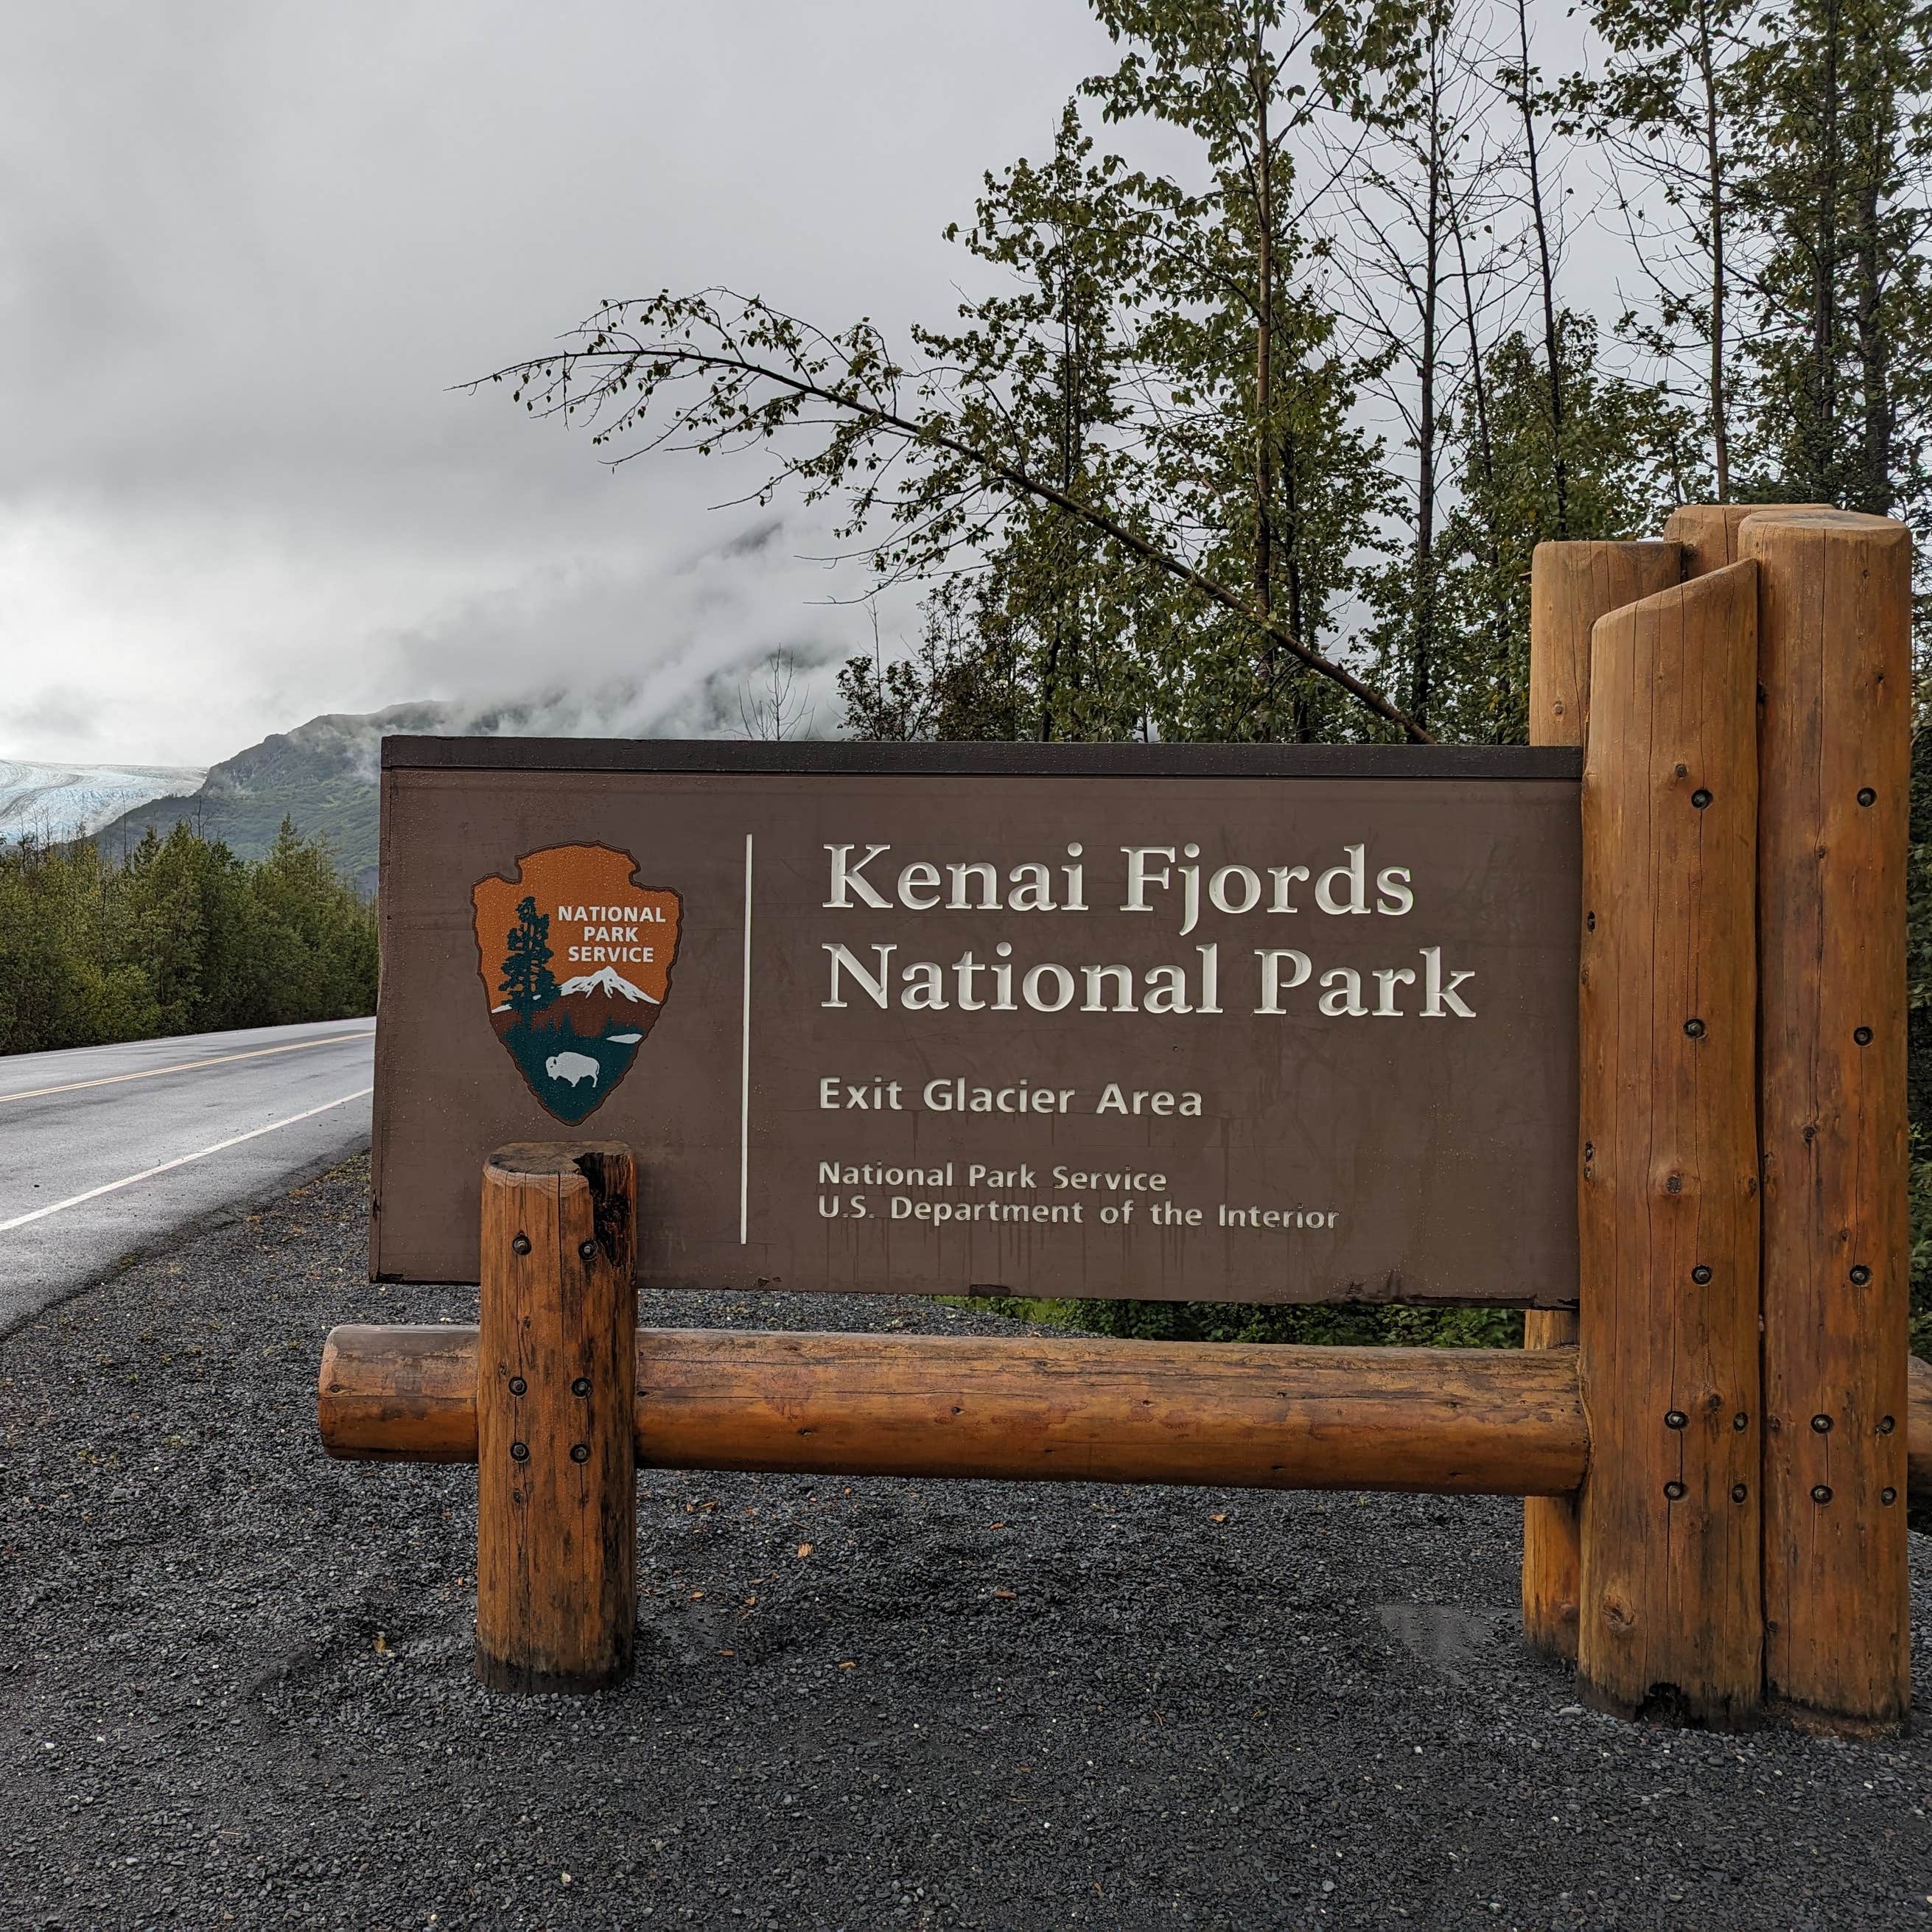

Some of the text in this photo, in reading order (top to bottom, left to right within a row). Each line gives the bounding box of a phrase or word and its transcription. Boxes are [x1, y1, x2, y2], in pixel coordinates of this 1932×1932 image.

[822, 842, 1414, 937] Kenai Fjords
[558, 906, 666, 923] NATIONAL
[583, 926, 638, 942] PARK
[568, 946, 654, 962] SERVICE
[821, 942, 1477, 1018] National Park
[819, 1077, 1203, 1117] Exit Glacier Area
[819, 1162, 1167, 1192] National Park Service
[819, 1194, 1339, 1229] U.S. Department of the Interior
